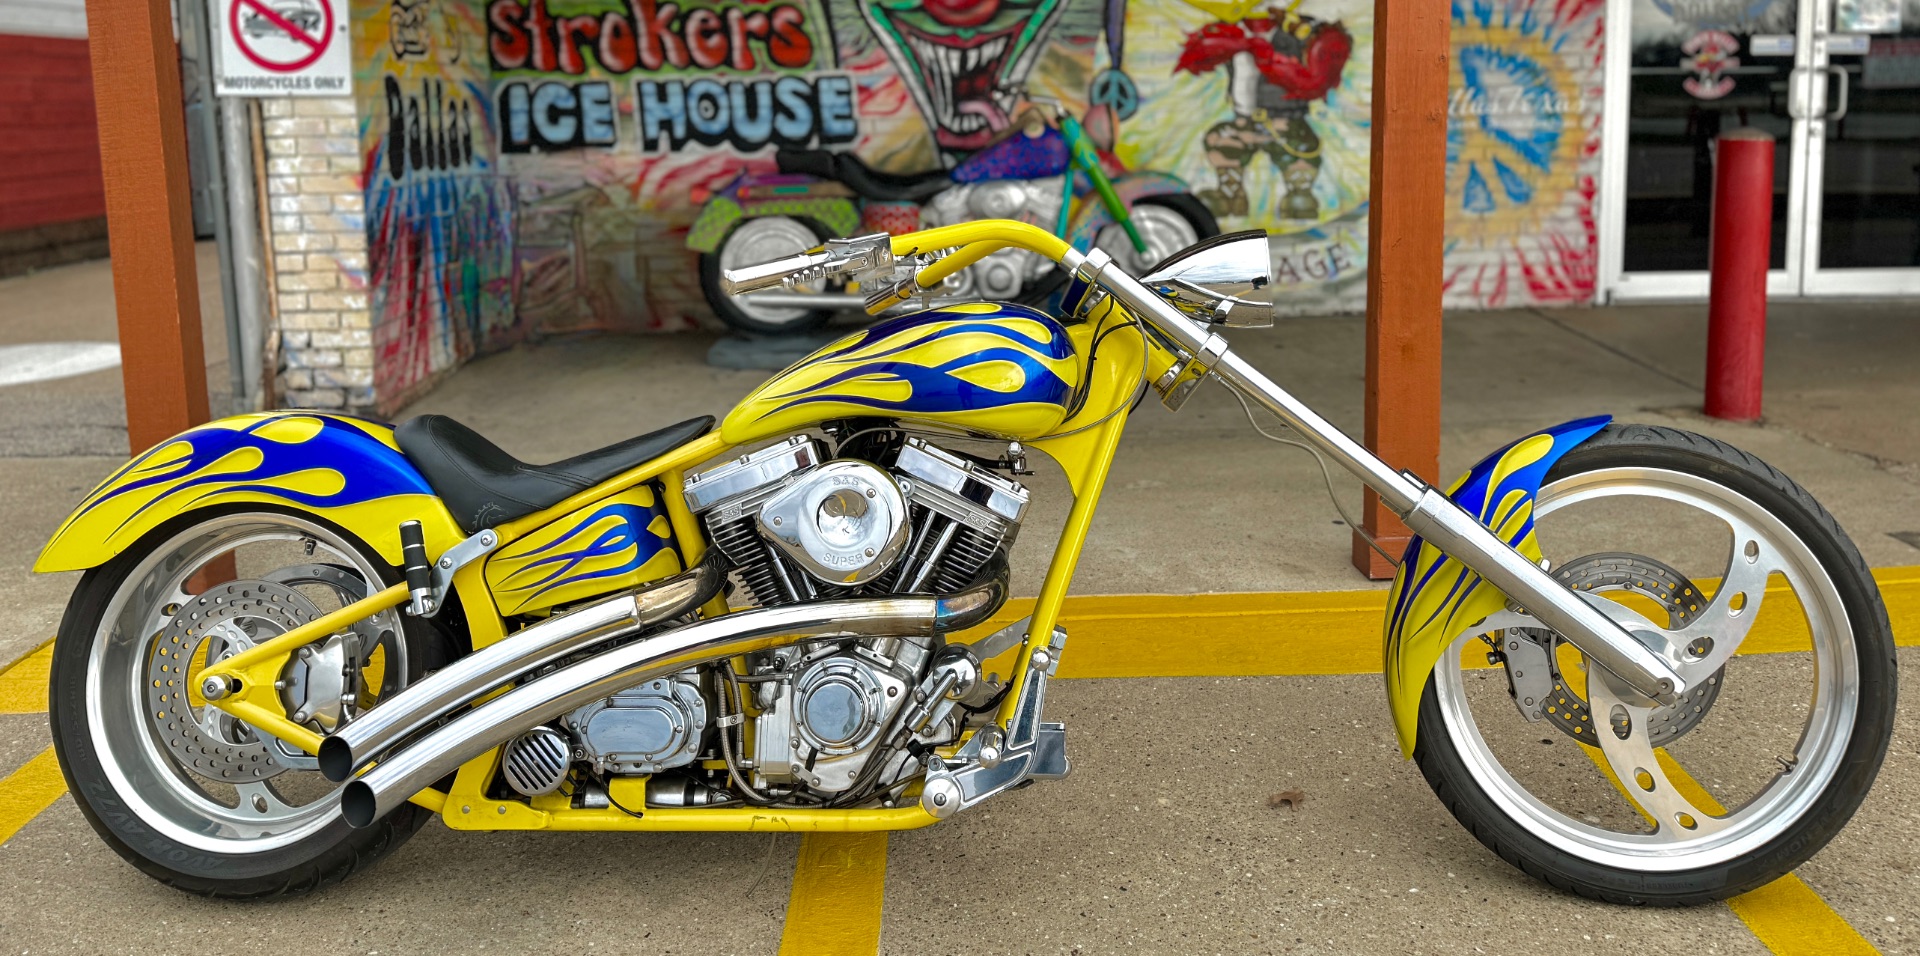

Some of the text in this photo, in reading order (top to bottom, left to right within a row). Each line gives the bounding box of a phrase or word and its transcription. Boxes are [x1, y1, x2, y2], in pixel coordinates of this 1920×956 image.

[488, 0, 814, 74] Strokers
[223, 76, 345, 90] MOTORCYCLES ONLY
[384, 74, 472, 181] Dallas
[501, 75, 859, 152] ICE HOUSE
[1276, 243, 1351, 285] AGE
[823, 552, 865, 566] SUPER
